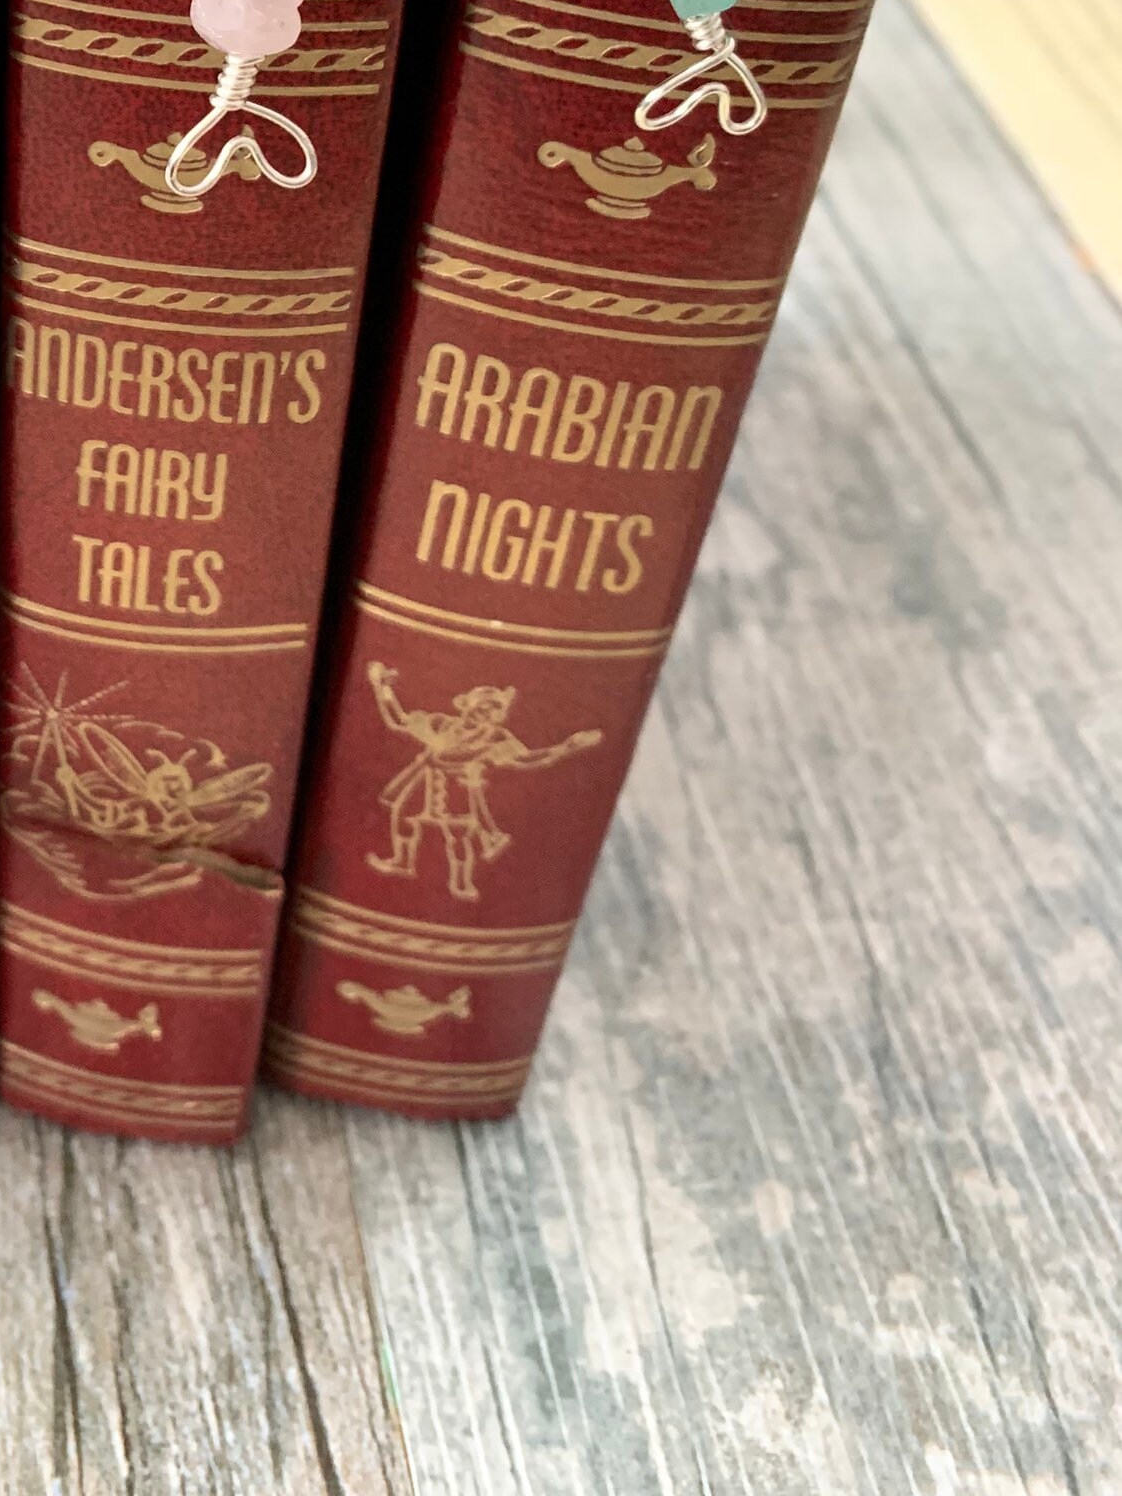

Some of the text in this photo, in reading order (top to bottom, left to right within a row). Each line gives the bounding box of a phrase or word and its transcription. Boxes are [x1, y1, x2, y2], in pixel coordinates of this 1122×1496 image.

[7, 315, 326, 424] ANDERSEN'S
[415, 342, 723, 471] ARABIAN
[76, 440, 228, 521] FAIRY
[72, 534, 224, 616] TALES
[415, 479, 655, 594] NIGHTS
